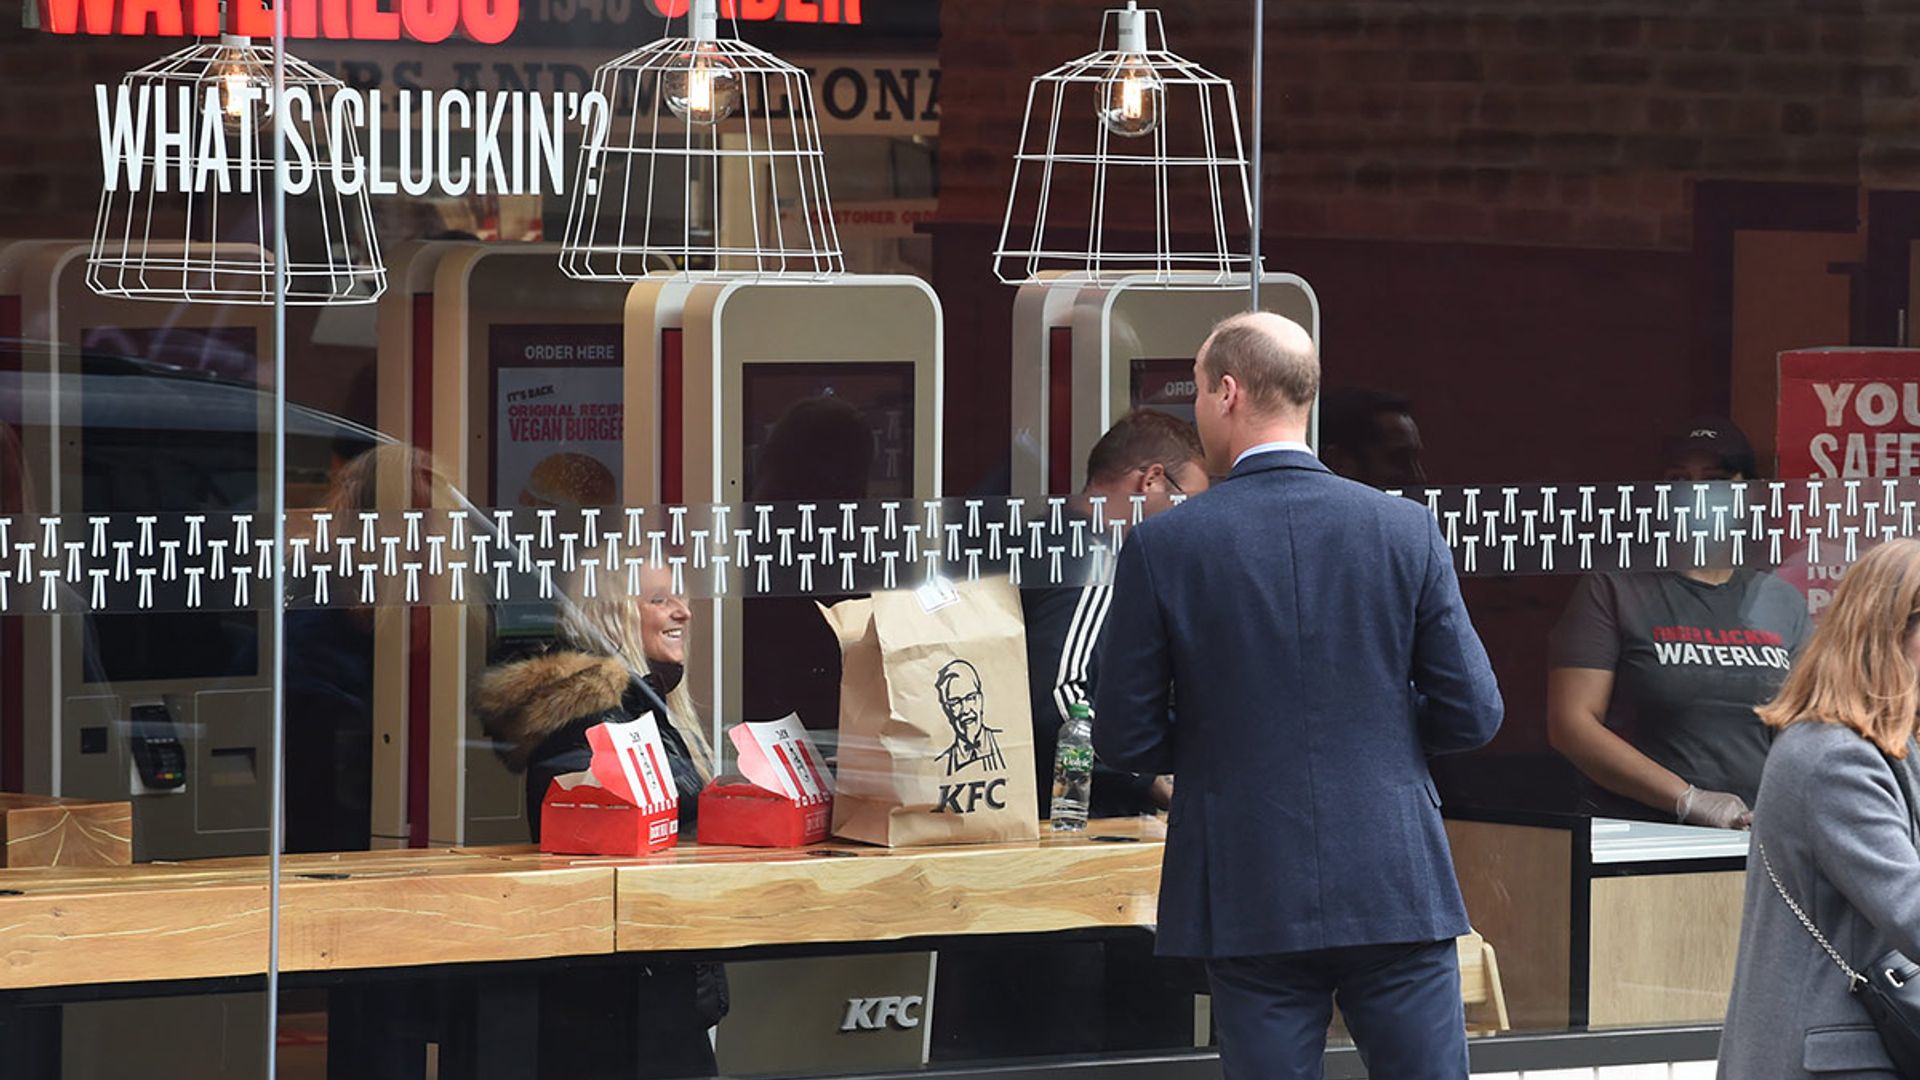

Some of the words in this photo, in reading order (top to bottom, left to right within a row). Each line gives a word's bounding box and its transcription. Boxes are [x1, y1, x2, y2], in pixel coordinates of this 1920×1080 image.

[95, 84, 313, 194] WHAT'S
[331, 88, 609, 195] CLUCKIN'?
[524, 345, 574, 360] ORDER
[576, 345, 615, 360] HERE
[1165, 381, 1197, 396] ORD
[508, 403, 575, 417] ORIGINAL
[580, 403, 624, 417] RECIP
[509, 418, 562, 442] VEGAN
[930, 778, 1007, 814] KFC
[840, 995, 923, 1031] KFC
